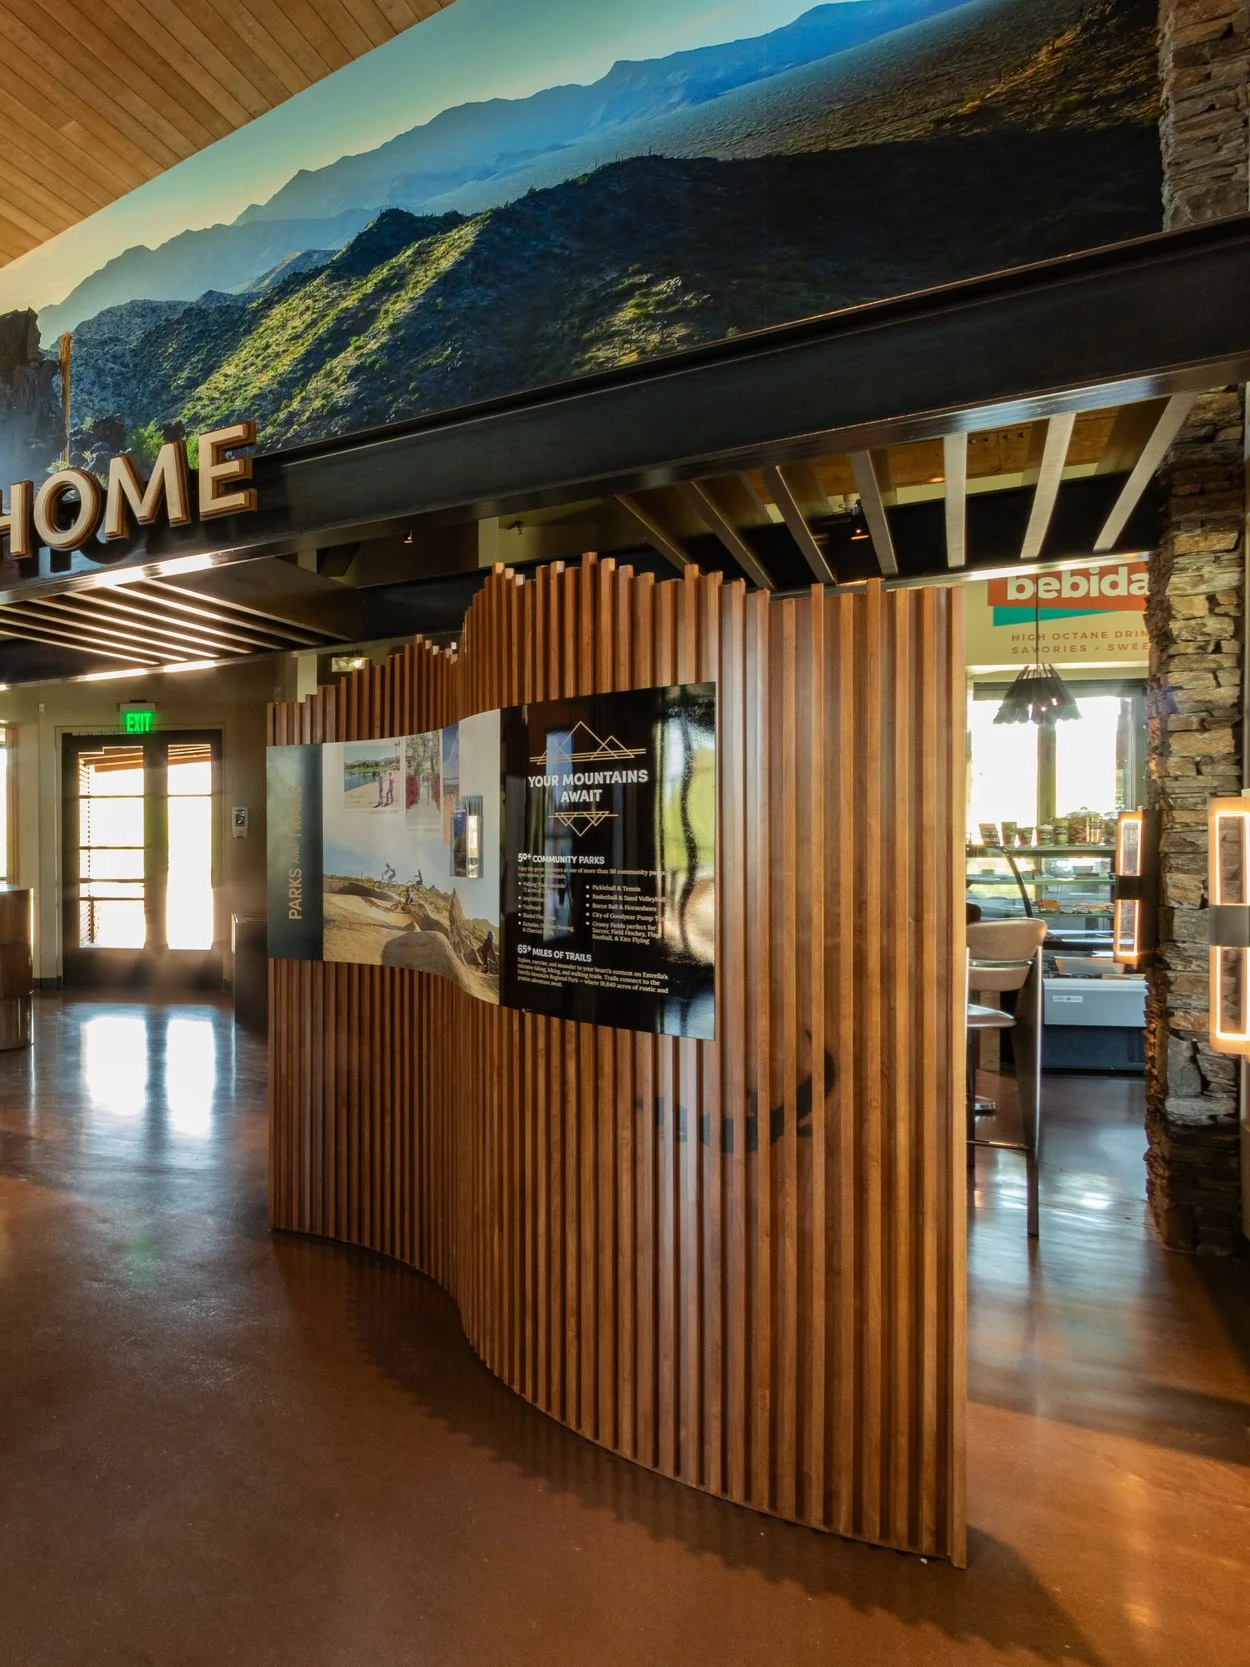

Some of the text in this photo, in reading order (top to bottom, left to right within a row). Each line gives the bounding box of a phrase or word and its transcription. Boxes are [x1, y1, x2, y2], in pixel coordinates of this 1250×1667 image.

[1011, 633, 1045, 641] HIGH
[1052, 631, 1108, 640] OCTANE
[1011, 642, 1149, 654] SAVORIES SWEE
[126, 712, 151, 733] EXIT
[528, 769, 649, 788] YOUR MOUNTAINS
[560, 789, 603, 803] AWAIT
[517, 853, 605, 865] 50+ COMMUNITY PARKS
[288, 868, 302, 920] PARKS
[517, 944, 592, 962] 65+ MILES OF TRAILS
[619, 976, 641, 984] connect
